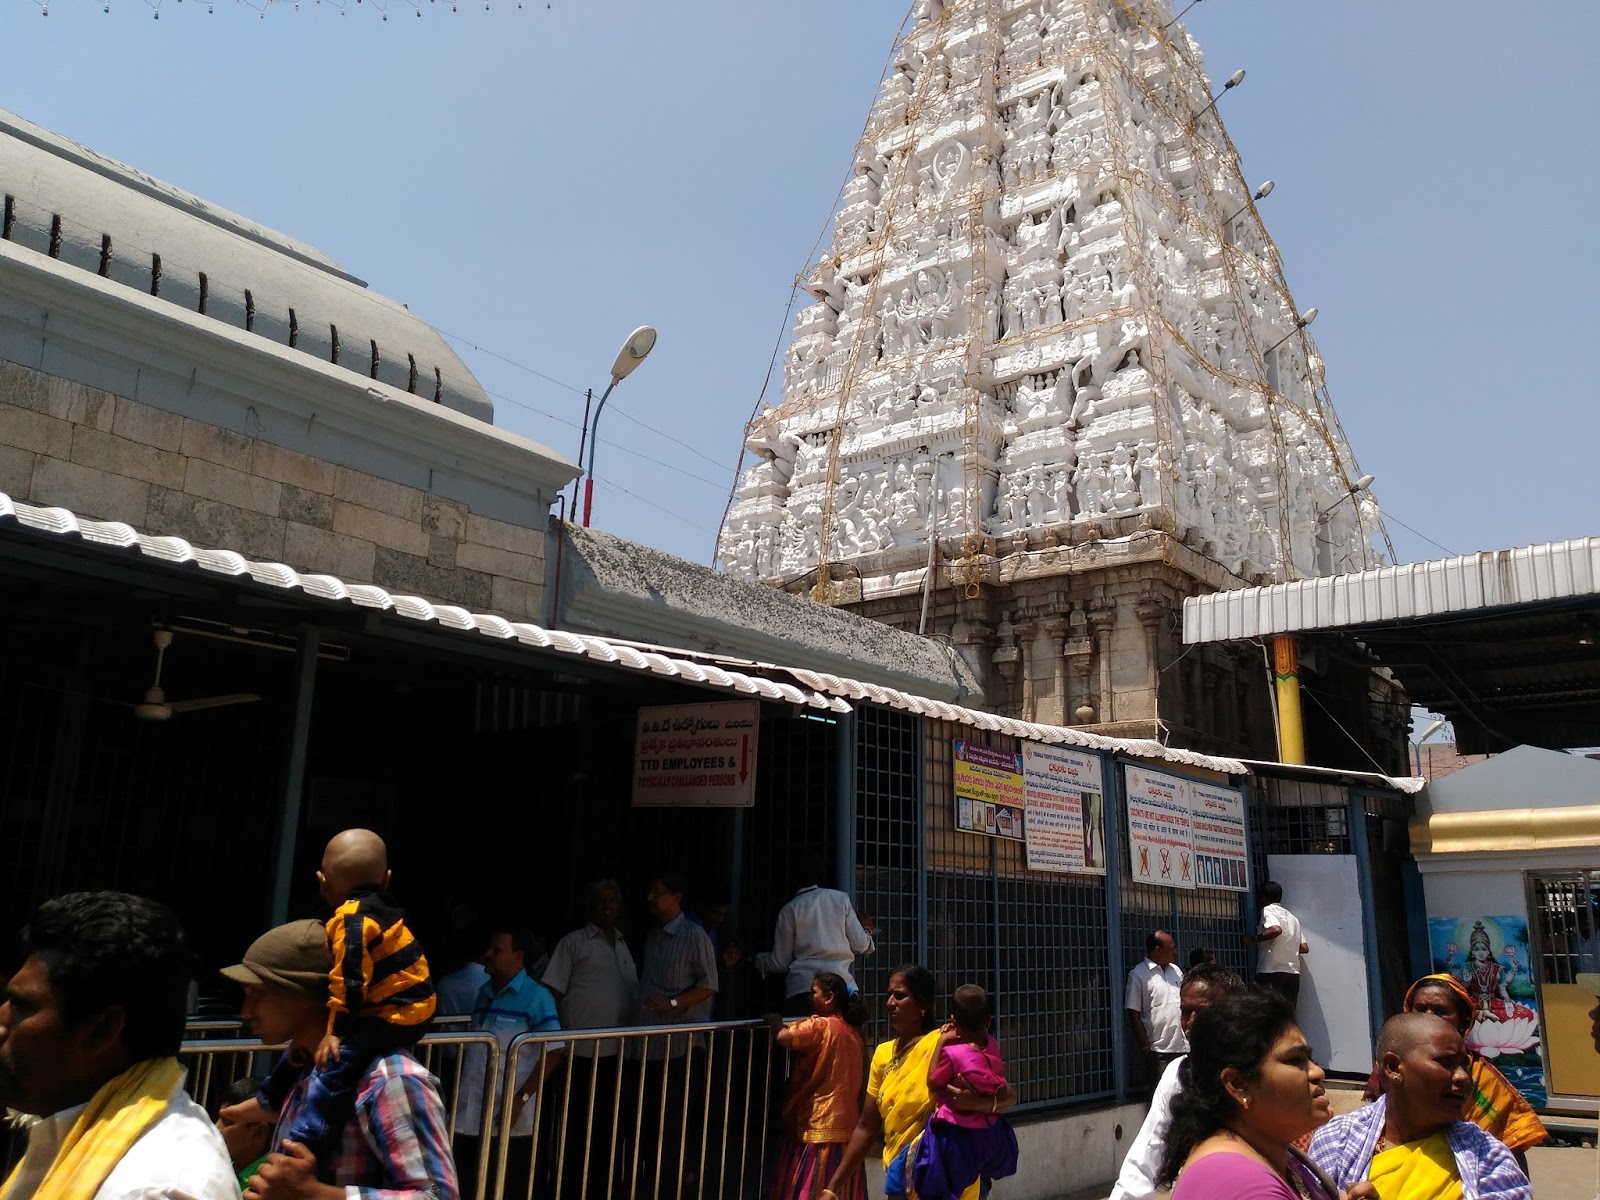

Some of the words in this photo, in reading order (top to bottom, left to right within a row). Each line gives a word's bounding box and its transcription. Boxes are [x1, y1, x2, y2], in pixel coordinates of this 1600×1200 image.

[640, 759, 659, 770] TTD
[663, 756, 725, 770] EMPLOYEES
[728, 756, 736, 768] &
[638, 775, 670, 788] PHYSICALLY
[709, 774, 736, 786] PERSONS
